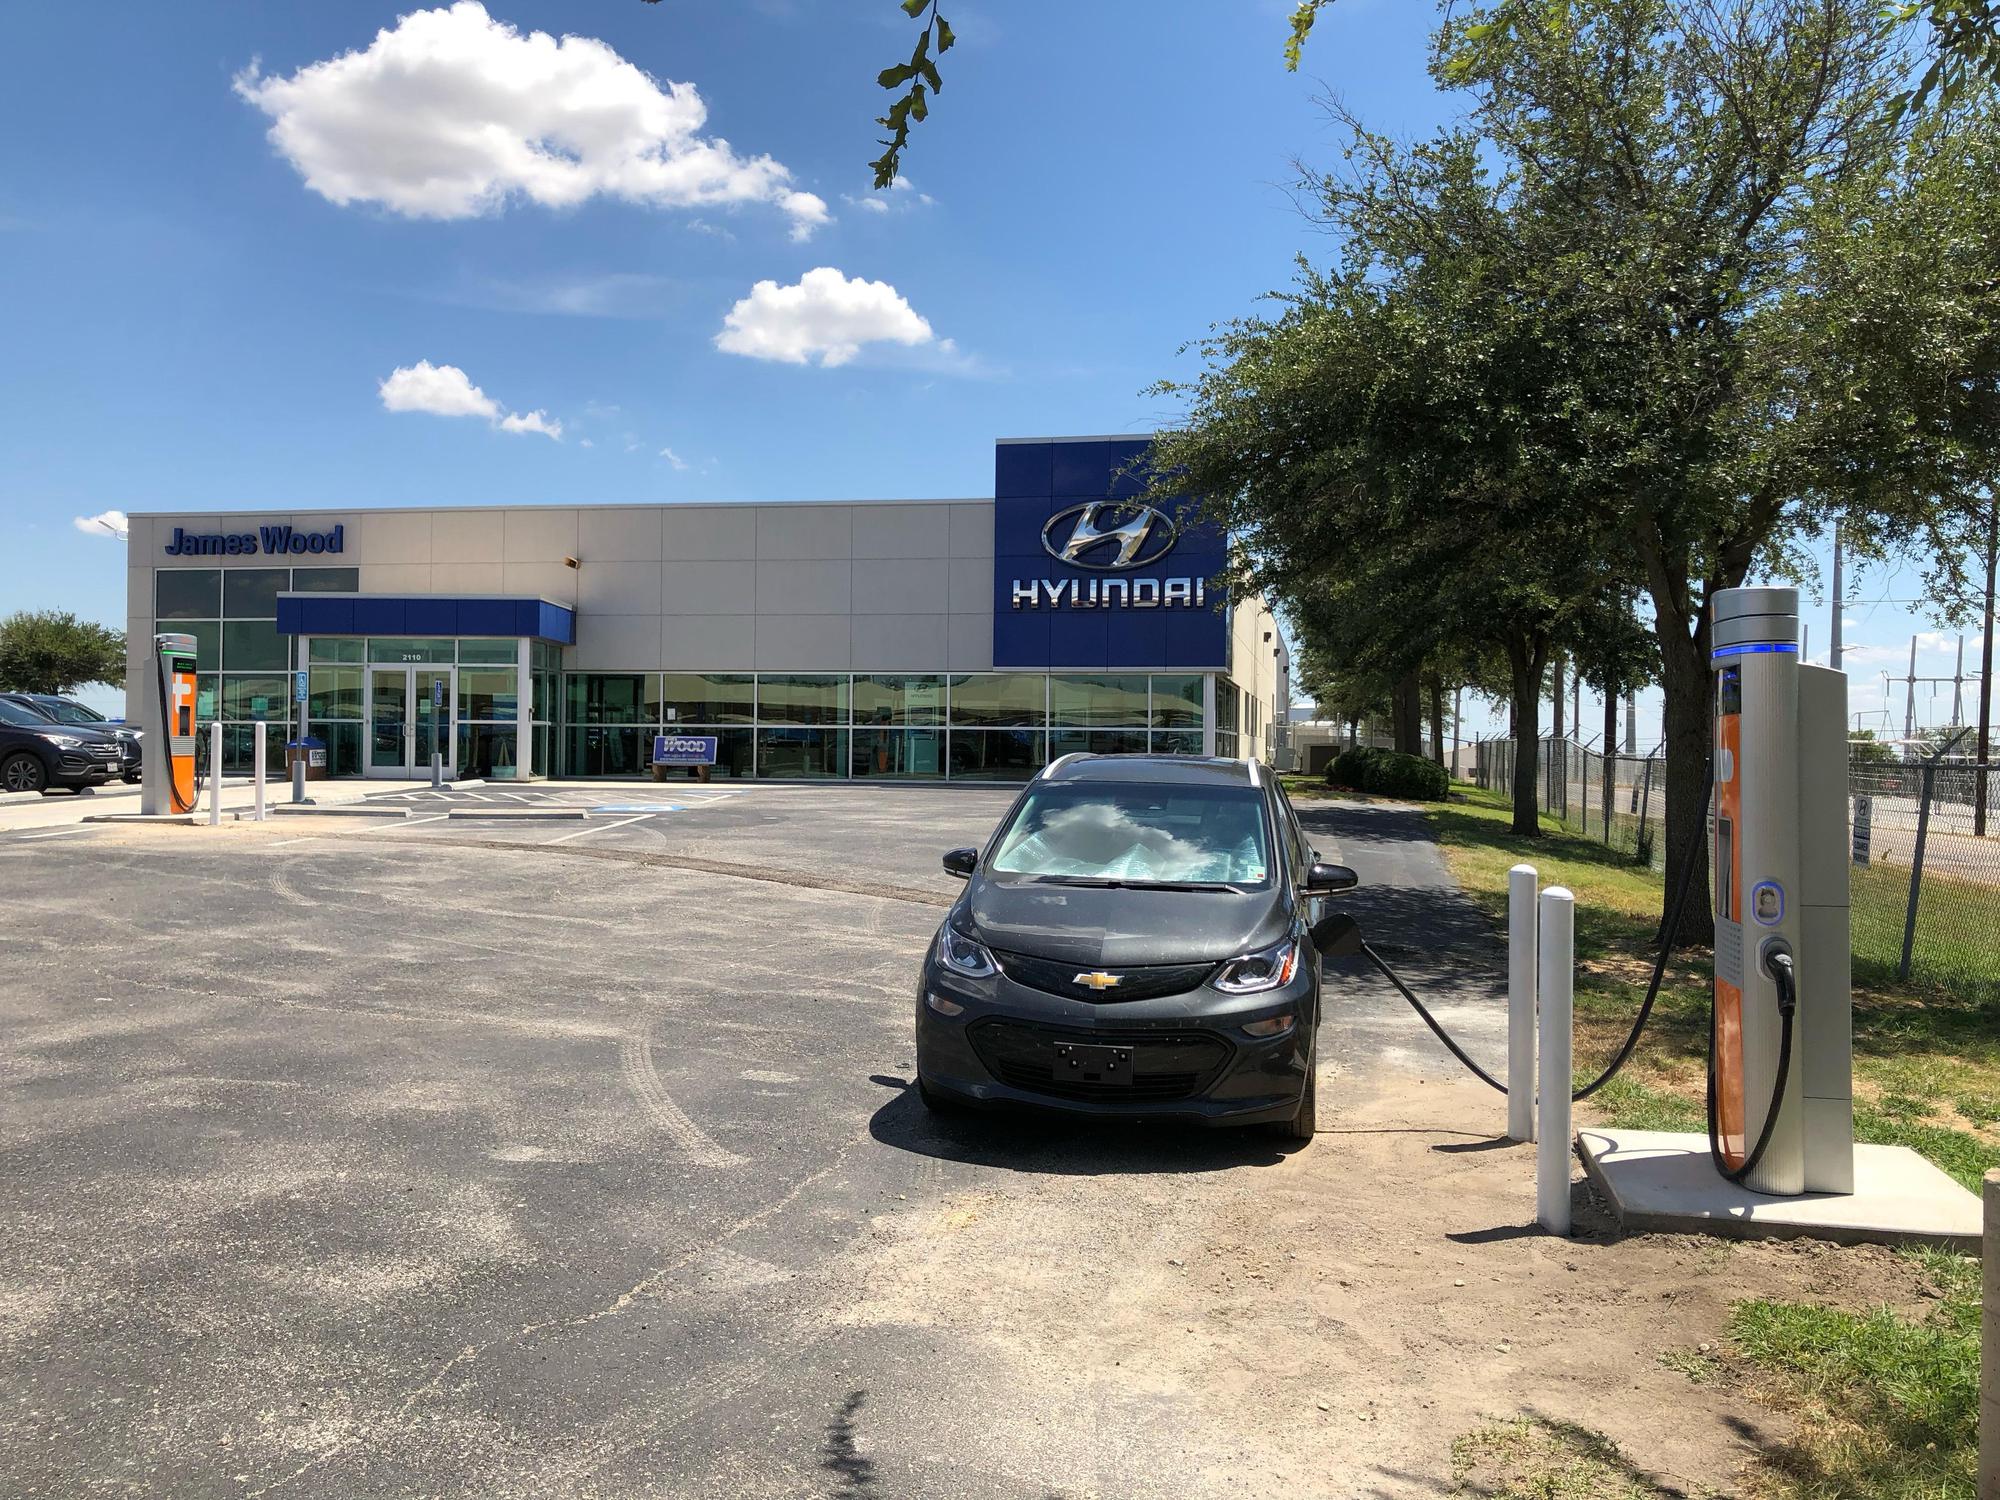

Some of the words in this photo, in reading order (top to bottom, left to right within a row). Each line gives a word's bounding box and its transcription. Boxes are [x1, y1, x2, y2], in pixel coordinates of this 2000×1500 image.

[165, 527, 258, 556] James
[259, 524, 344, 554] Wood
[1012, 577, 1205, 608] HYUNDAI
